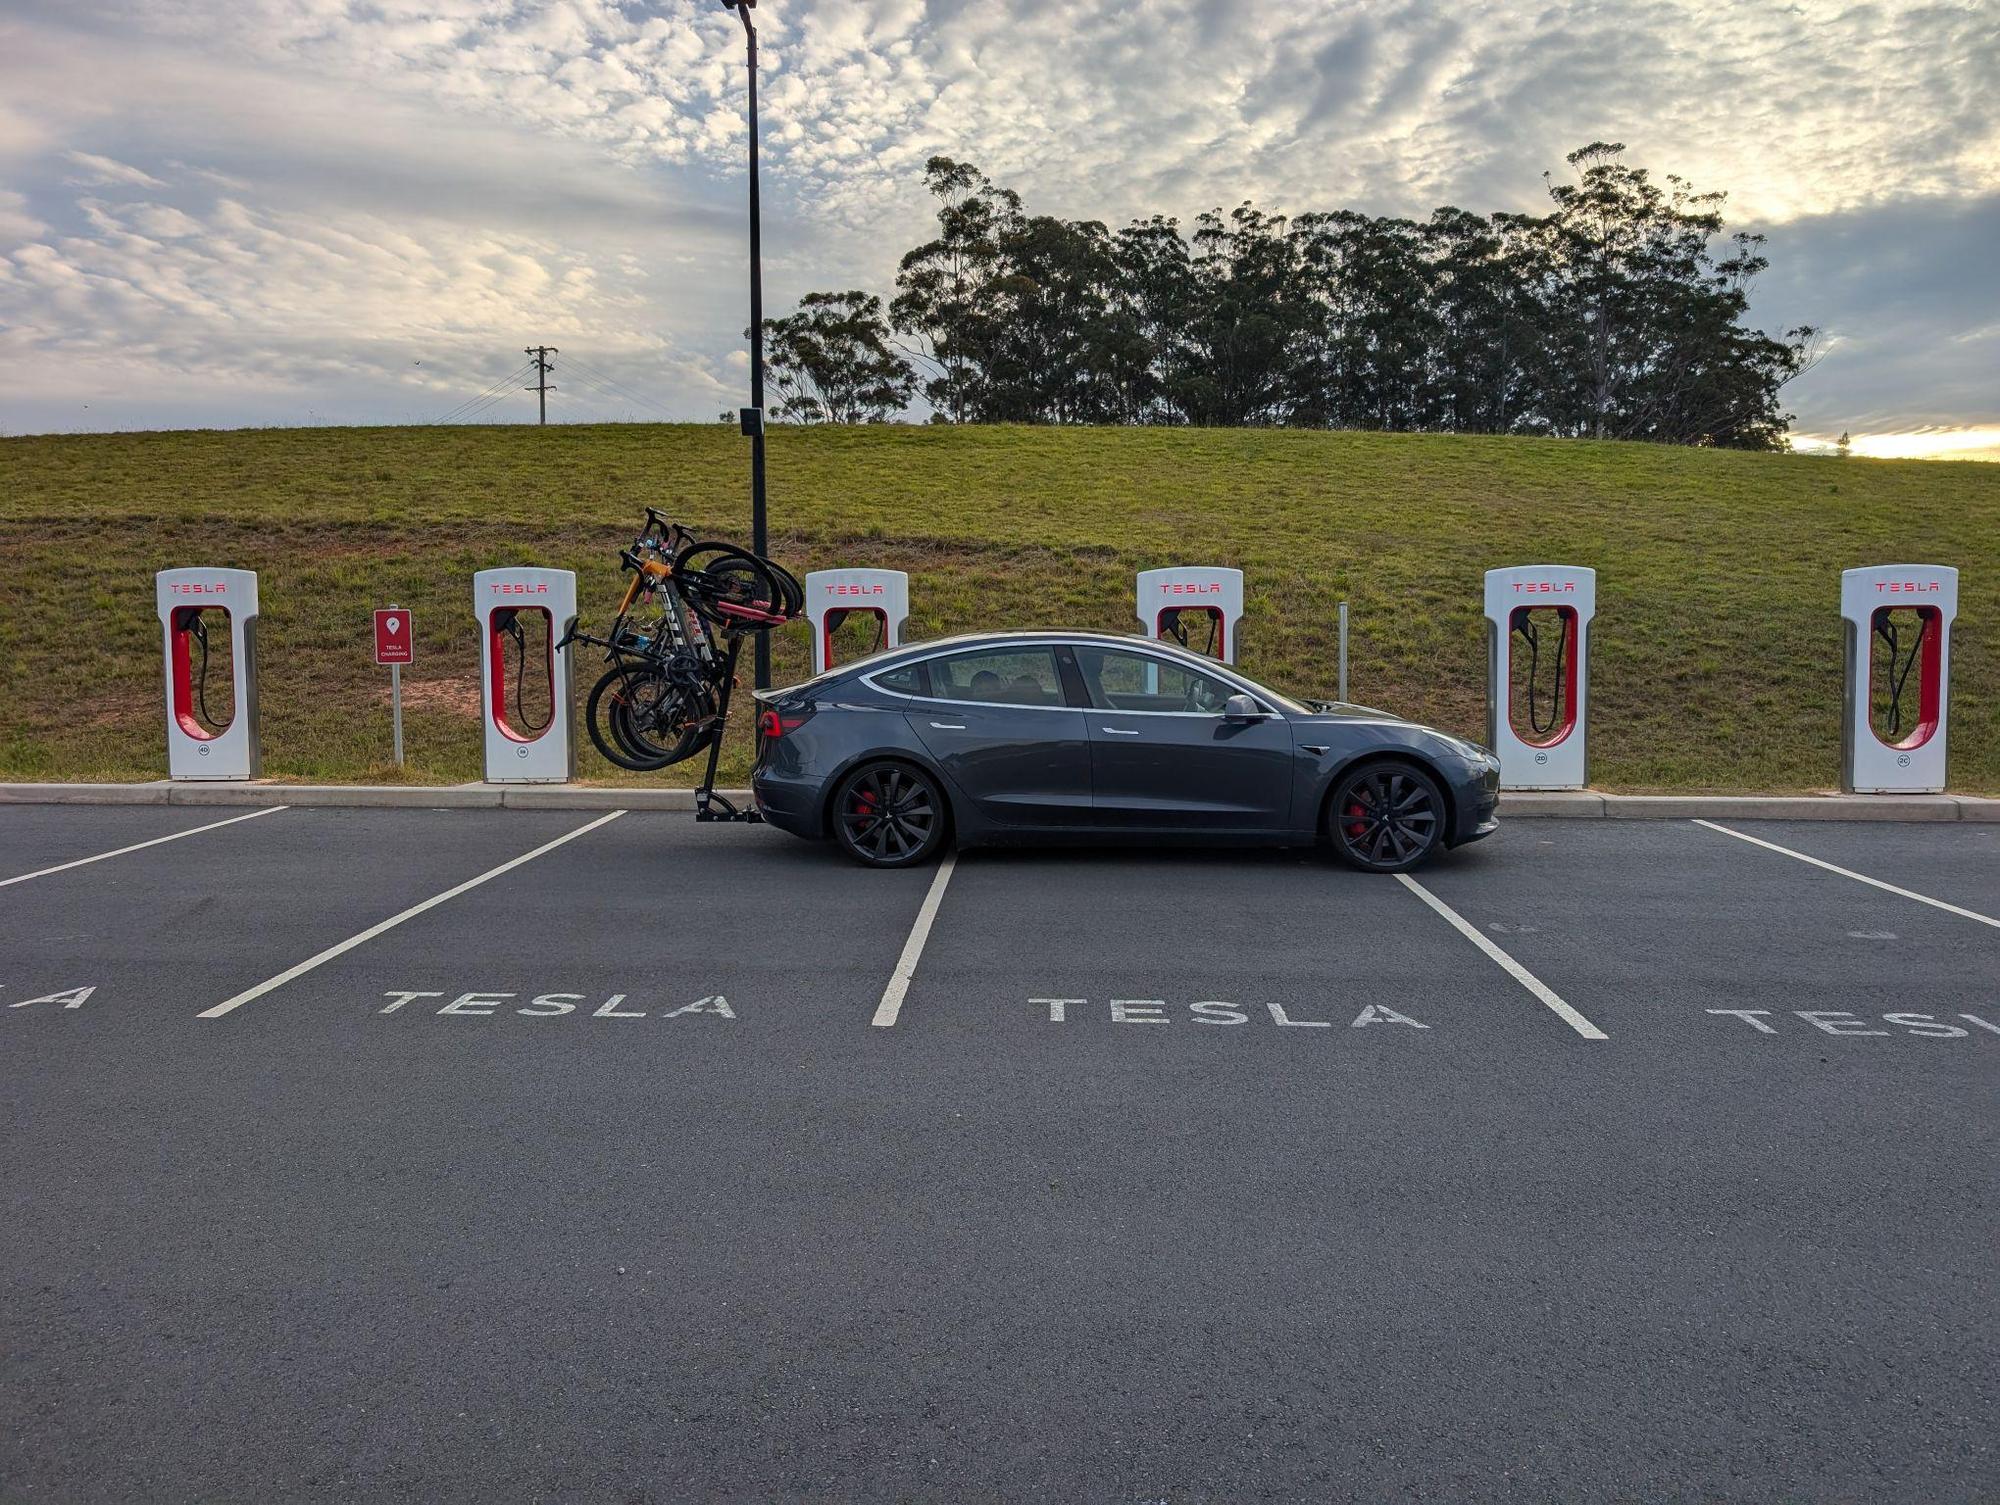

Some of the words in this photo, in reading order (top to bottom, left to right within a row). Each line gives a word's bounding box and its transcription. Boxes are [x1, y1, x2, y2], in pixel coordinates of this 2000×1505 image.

[171, 584, 226, 593] TESLA
[490, 584, 548, 593] TESLA
[825, 585, 883, 595] TESLA
[1160, 584, 1221, 593] TESLA
[1512, 583, 1575, 593] TESLA
[1876, 582, 1941, 592] TESLA
[379, 992, 736, 1018] TESLA
[1028, 998, 1430, 1028] TESLA
